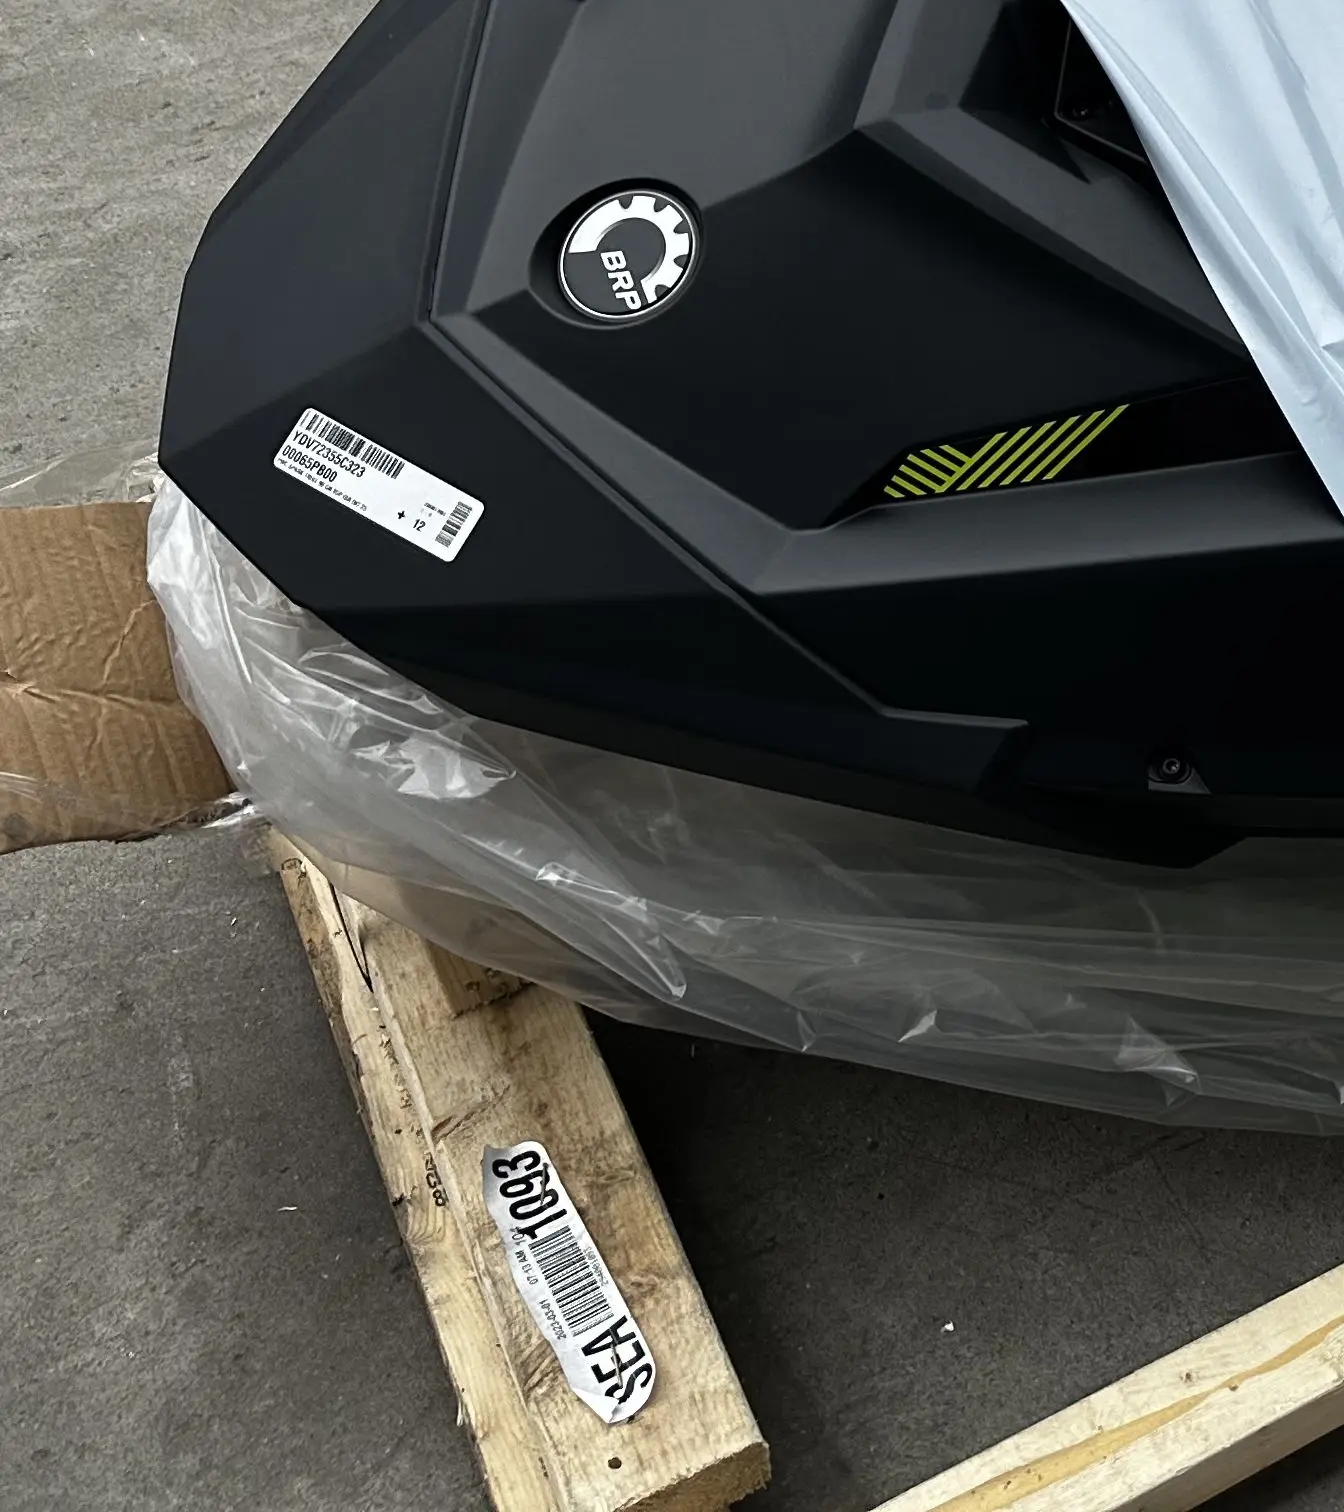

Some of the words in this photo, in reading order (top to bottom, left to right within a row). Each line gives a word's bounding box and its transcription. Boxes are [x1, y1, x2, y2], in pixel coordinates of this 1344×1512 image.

[600, 250, 642, 310] BRP
[411, 517, 426, 532] 12
[491, 1149, 568, 1240] 1093
[514, 1248, 529, 1264] AM
[537, 1296, 568, 1341] 2023-03-01
[581, 1315, 654, 1404] SEA
